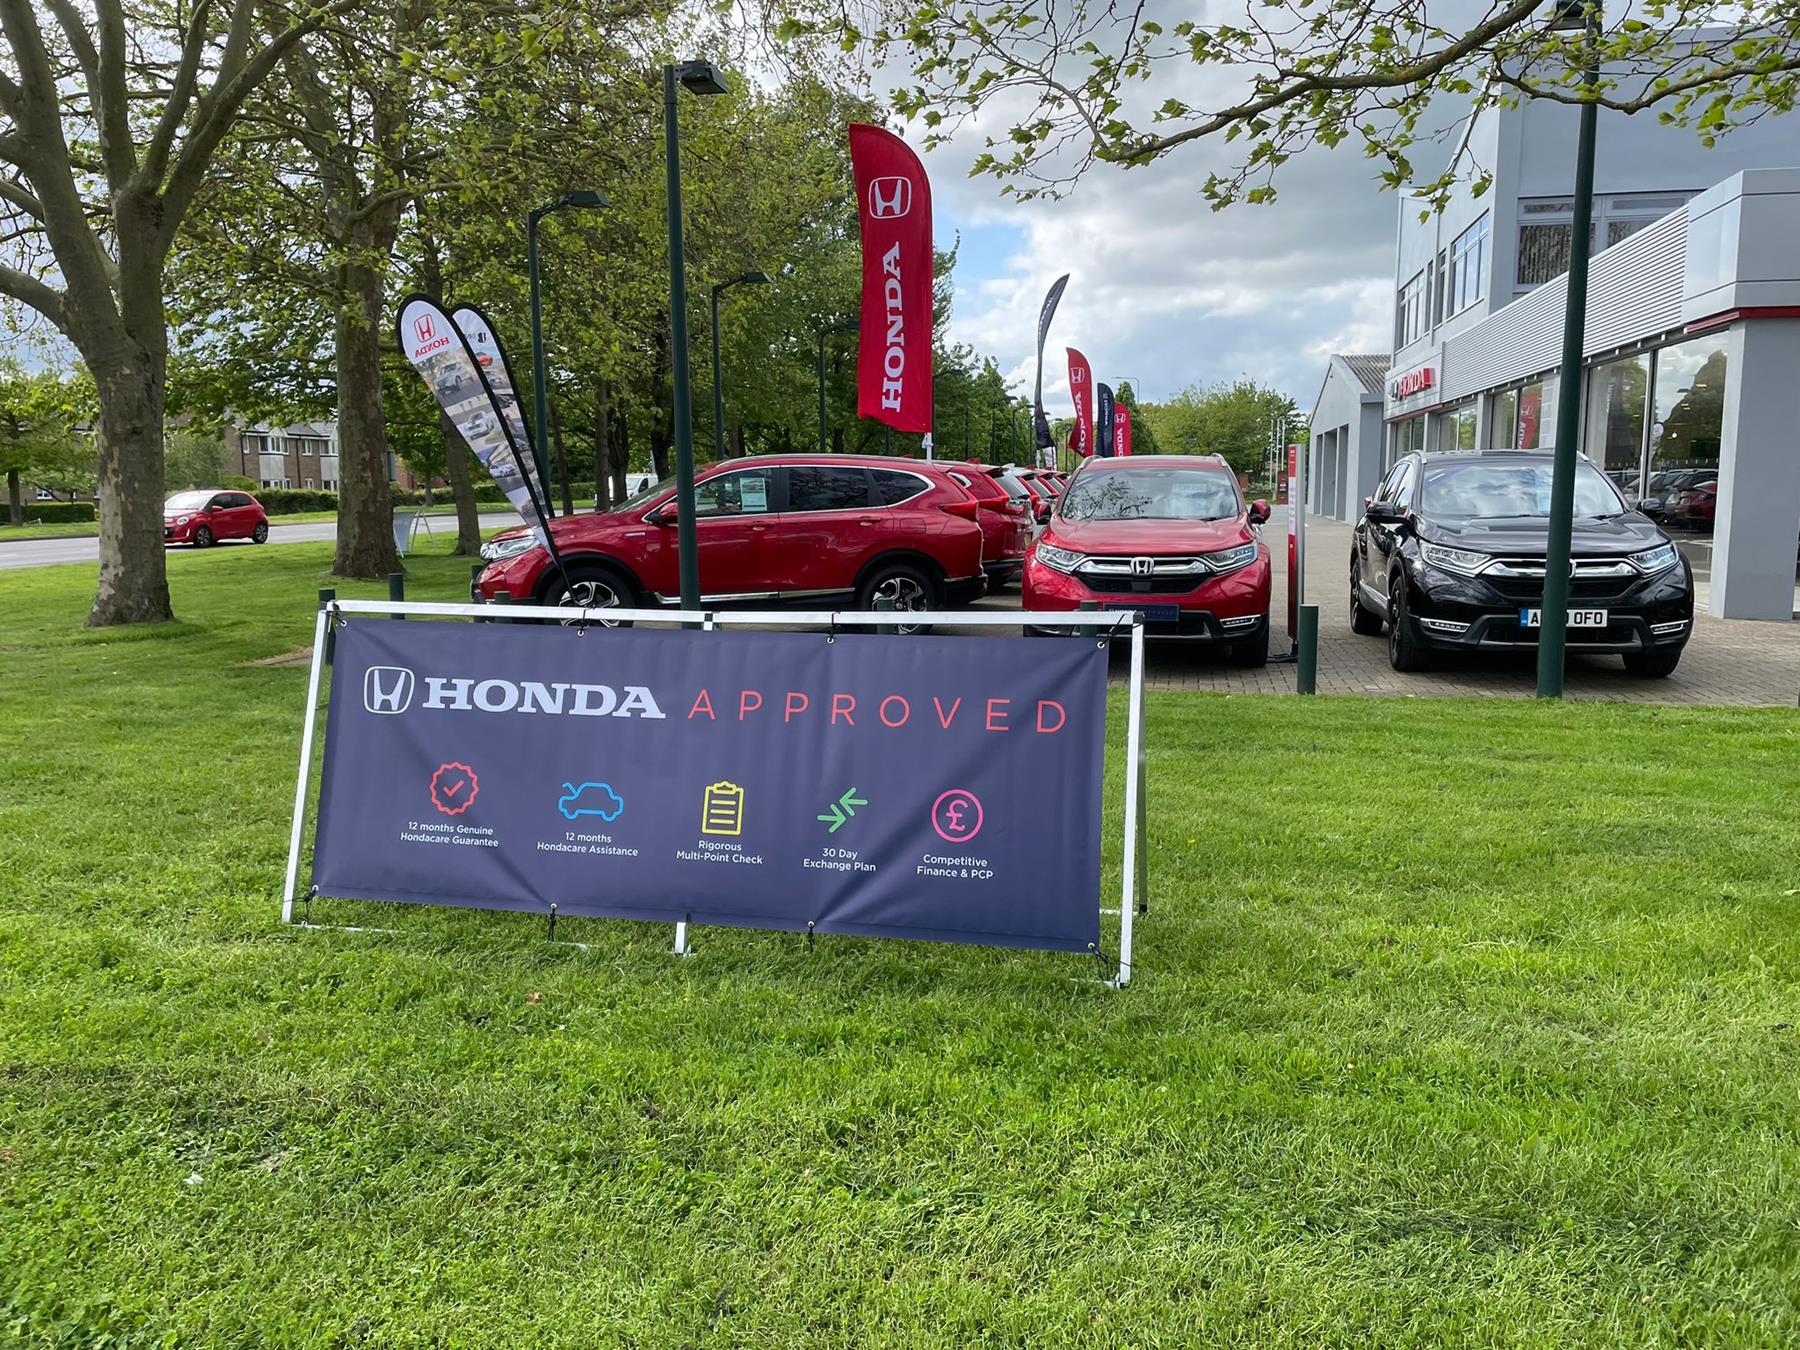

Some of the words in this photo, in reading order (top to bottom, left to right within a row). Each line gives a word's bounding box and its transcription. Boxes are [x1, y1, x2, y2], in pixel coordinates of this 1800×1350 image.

[881, 241, 905, 413] HONDA
[1116, 427, 1124, 457] ONDA
[1574, 611, 1603, 625] OFO
[423, 678, 666, 719] HONDA
[689, 689, 1066, 733] APPROVED
[408, 821, 418, 831] 12
[420, 823, 455, 834] months
[457, 825, 494, 836] Genuine
[400, 832, 450, 844] Hondacare
[452, 836, 499, 848] Guarantee
[565, 832, 575, 842] 12
[577, 833, 612, 844] months
[537, 841, 587, 853] Hondacare
[589, 844, 639, 857] Assistance
[698, 840, 742, 852] Rigorous
[676, 850, 730, 864] Multi-Point
[732, 853, 763, 865] Check
[822, 848, 836, 858] 30
[838, 849, 858, 861] Day
[923, 853, 988, 868] Competitive
[803, 858, 852, 872] Exchange
[854, 861, 877, 872] Plan
[916, 865, 958, 878] Finance
[960, 868, 968, 878] &
[971, 869, 994, 880] PCP
